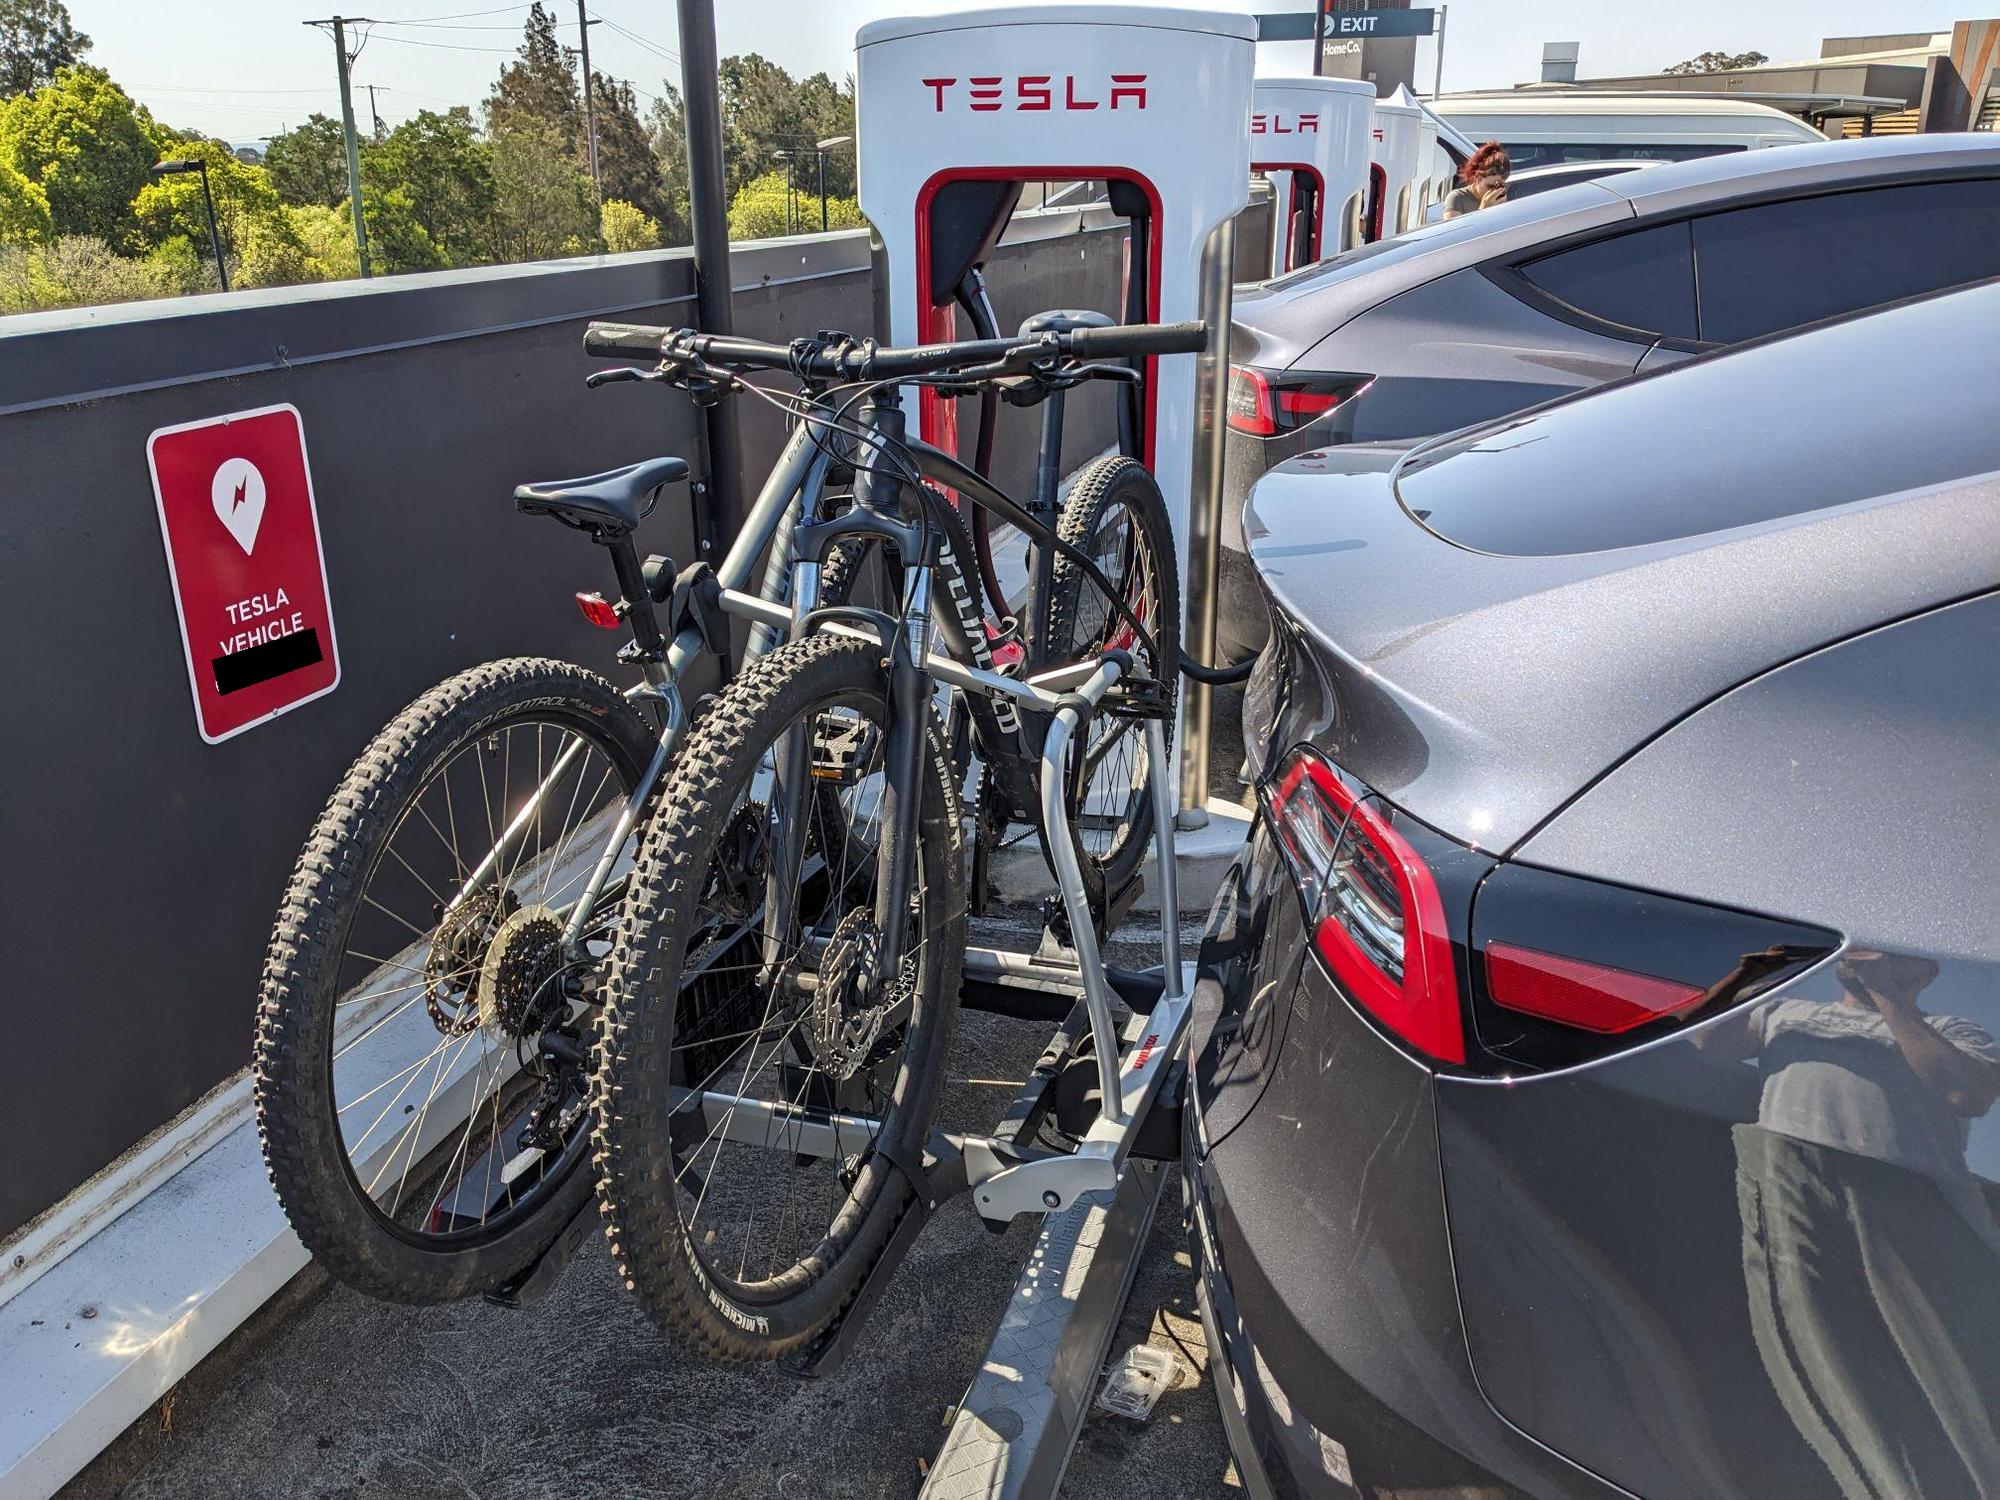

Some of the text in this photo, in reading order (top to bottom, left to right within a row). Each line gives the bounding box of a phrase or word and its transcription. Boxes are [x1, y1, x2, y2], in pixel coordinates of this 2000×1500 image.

[1340, 17, 1378, 32] EXIT
[922, 75, 1147, 112] TESLA
[1251, 114, 1319, 134] SLA
[225, 587, 290, 625] TESLA
[220, 611, 304, 656] VEHICLE
[494, 696, 567, 720] CONTROL
[934, 755, 958, 828] MICHELIN
[684, 1236, 756, 1333] MICHELIN WILD
